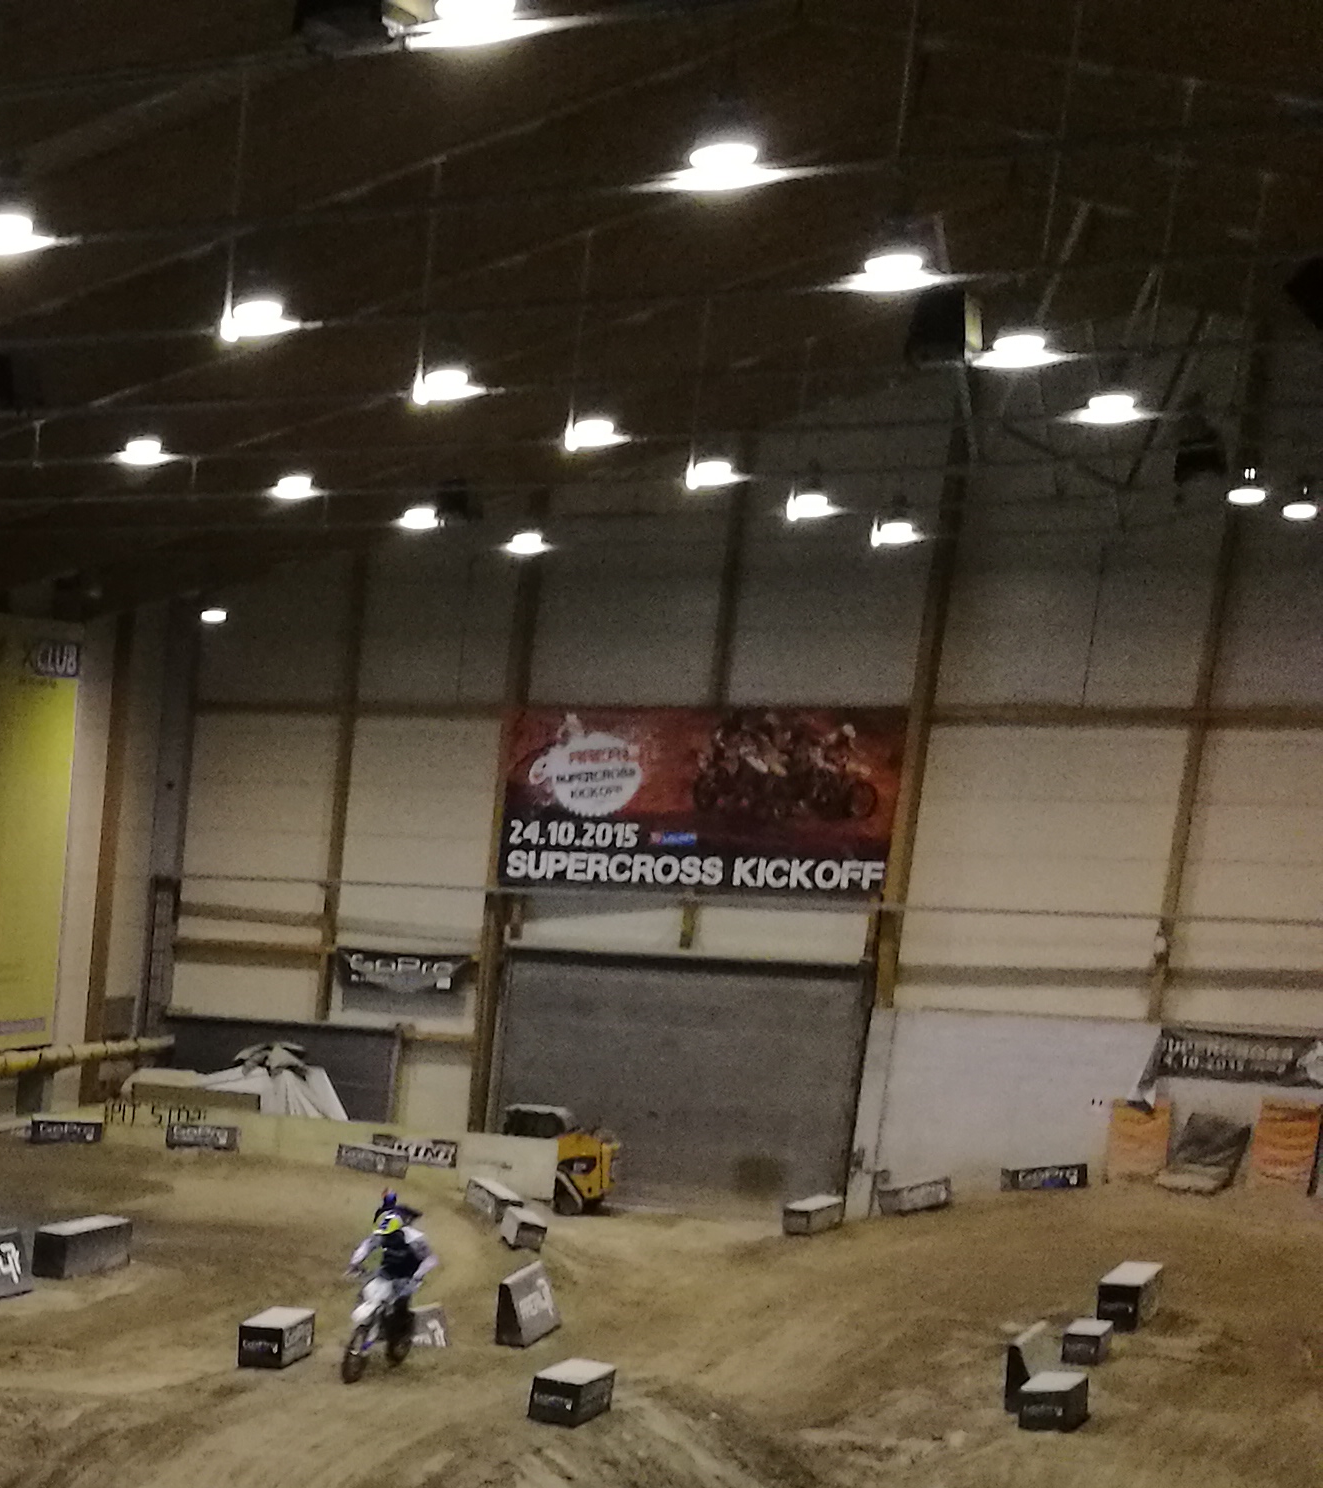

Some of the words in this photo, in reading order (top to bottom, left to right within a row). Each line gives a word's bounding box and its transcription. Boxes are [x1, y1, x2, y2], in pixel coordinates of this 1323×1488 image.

[508, 819, 640, 848] 24.10.2015
[506, 850, 724, 886] SUPERCROSS
[732, 857, 886, 889] KICKOFF
